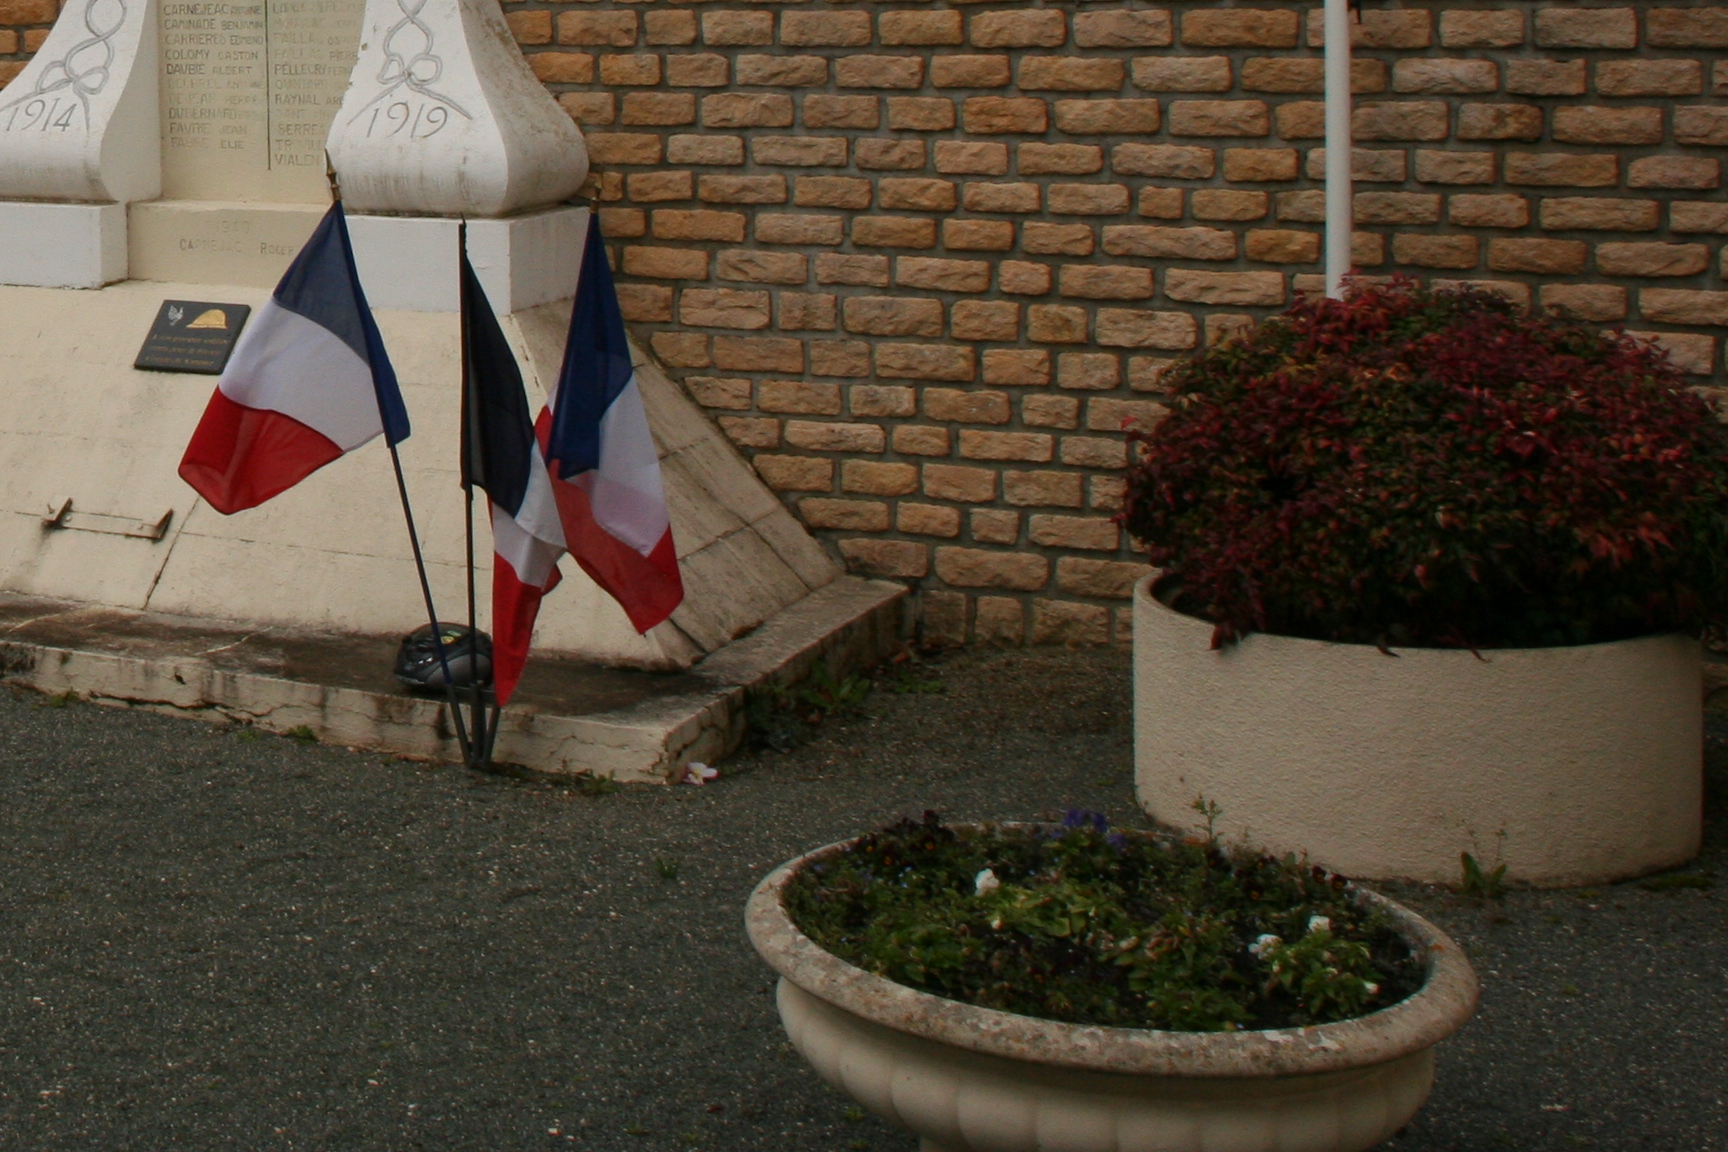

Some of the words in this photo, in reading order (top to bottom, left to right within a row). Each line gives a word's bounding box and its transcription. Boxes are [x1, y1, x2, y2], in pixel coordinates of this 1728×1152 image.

[275, 93, 321, 105] RAYNAL
[5, 97, 77, 133] 1914
[366, 100, 448, 139] 1919
[220, 139, 244, 149] ELIE
